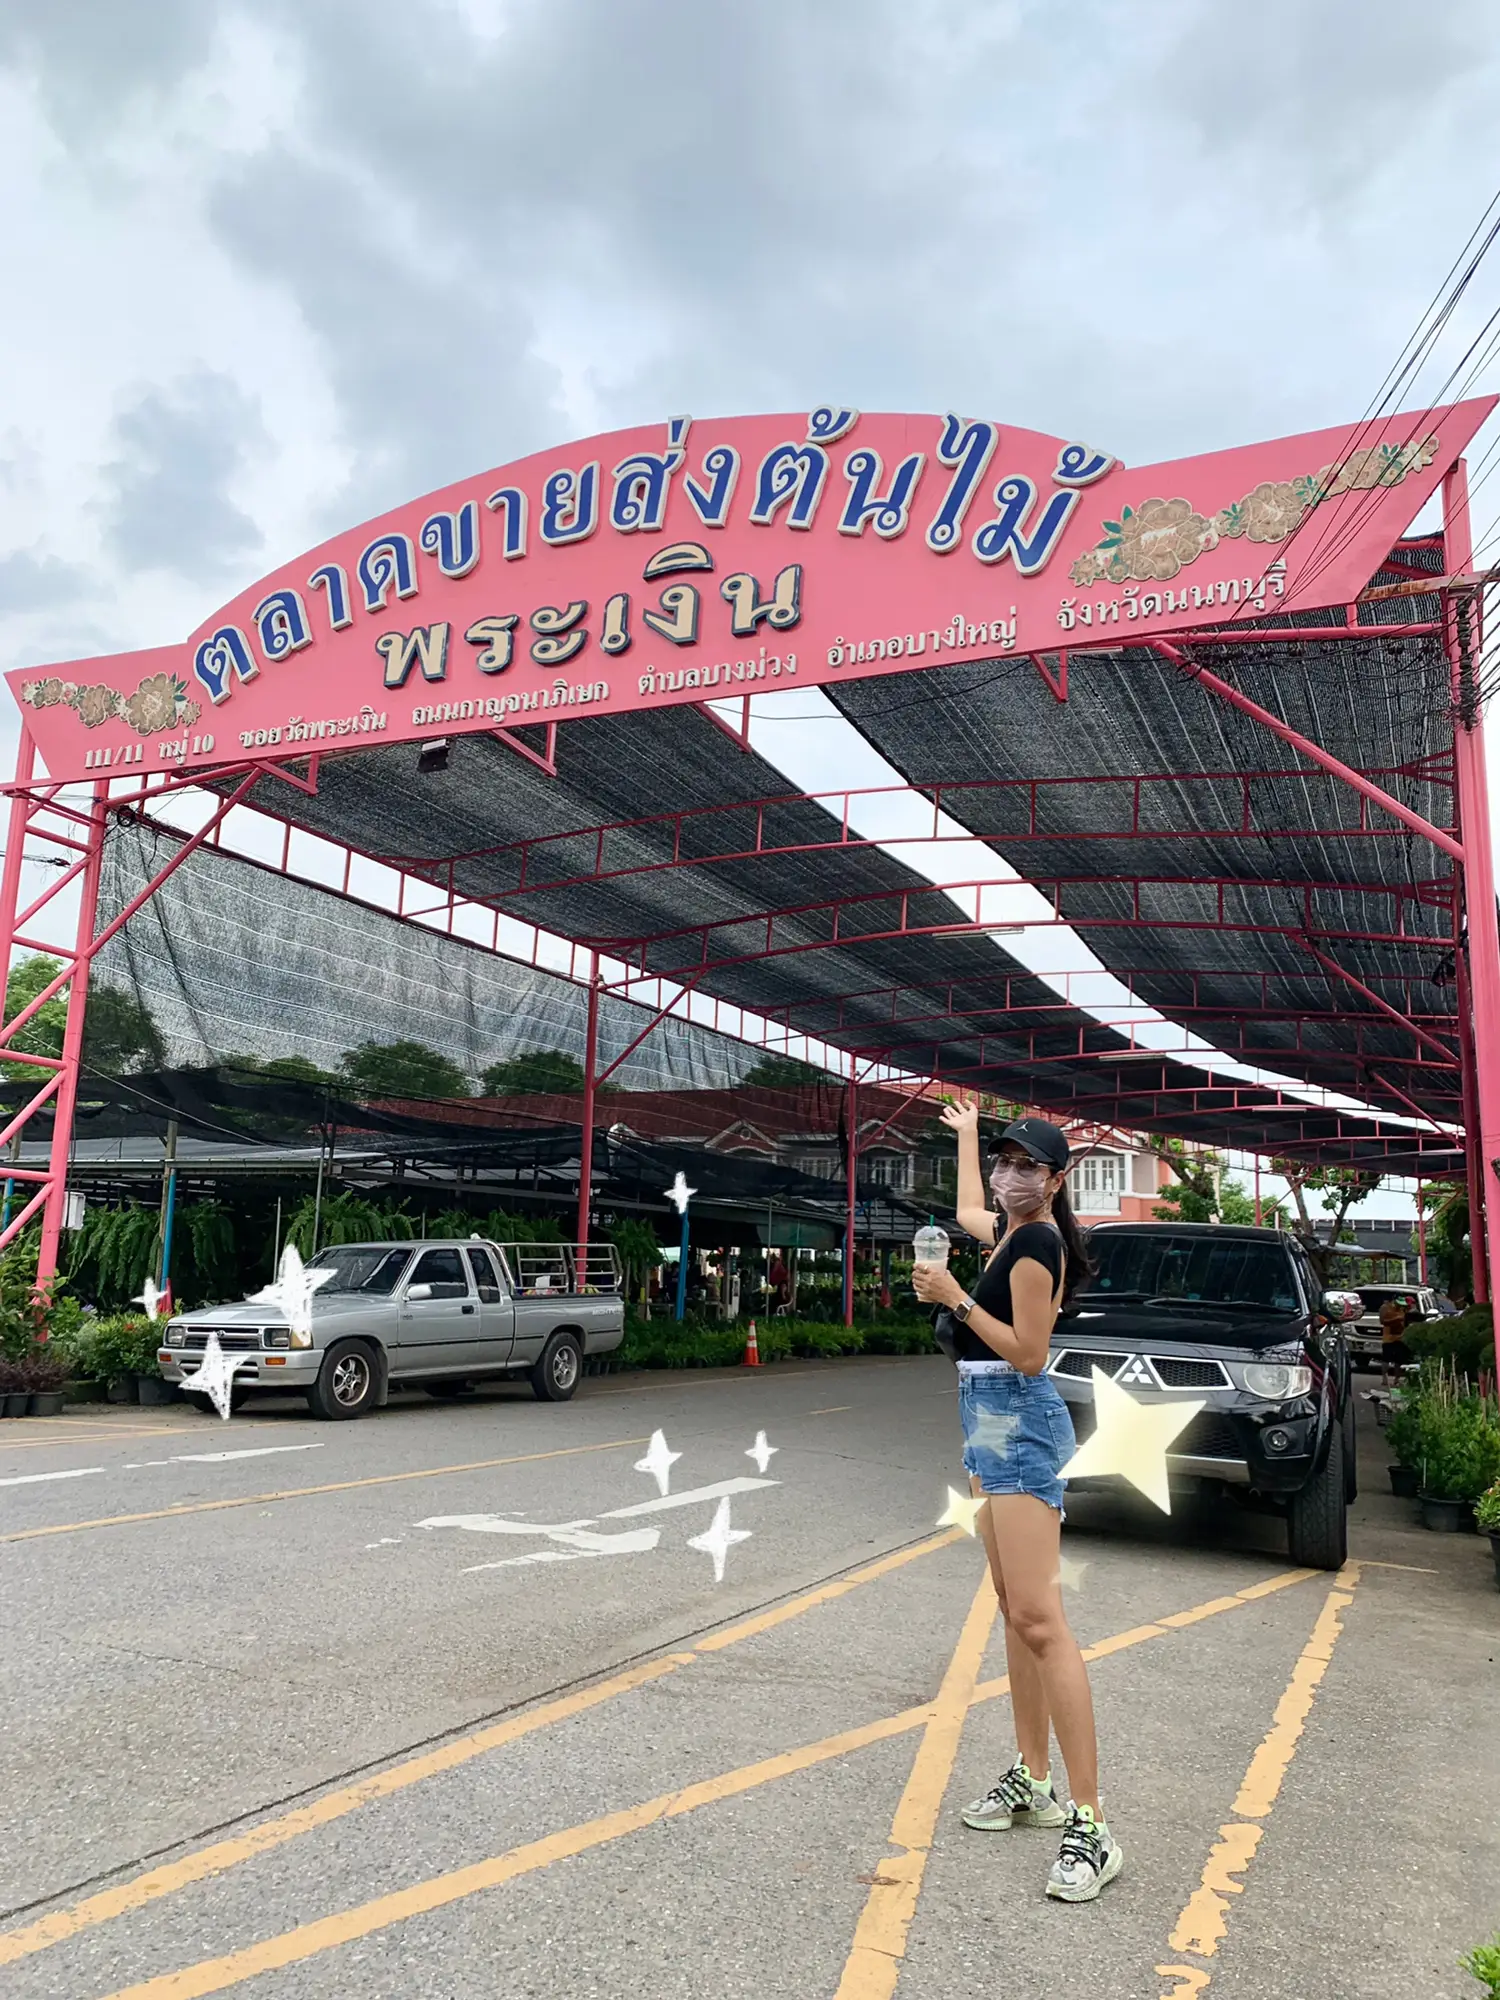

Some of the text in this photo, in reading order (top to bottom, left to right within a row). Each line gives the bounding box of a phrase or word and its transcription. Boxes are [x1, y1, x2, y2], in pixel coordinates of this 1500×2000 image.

[193, 405, 1116, 705] ตลาดขายส่งต้นไม้
[374, 541, 802, 690] พระเงิน
[85, 743, 144, 769] 111/11
[192, 733, 214, 754] 10
[411, 678, 609, 725] ถนนกาญจนาภิเษก
[638, 647, 797, 695] ตำบลบางม่วง
[826, 605, 1017, 668] อำเภอบางใหญ่
[1056, 558, 1288, 631] จังหวัดนนทบุรี
